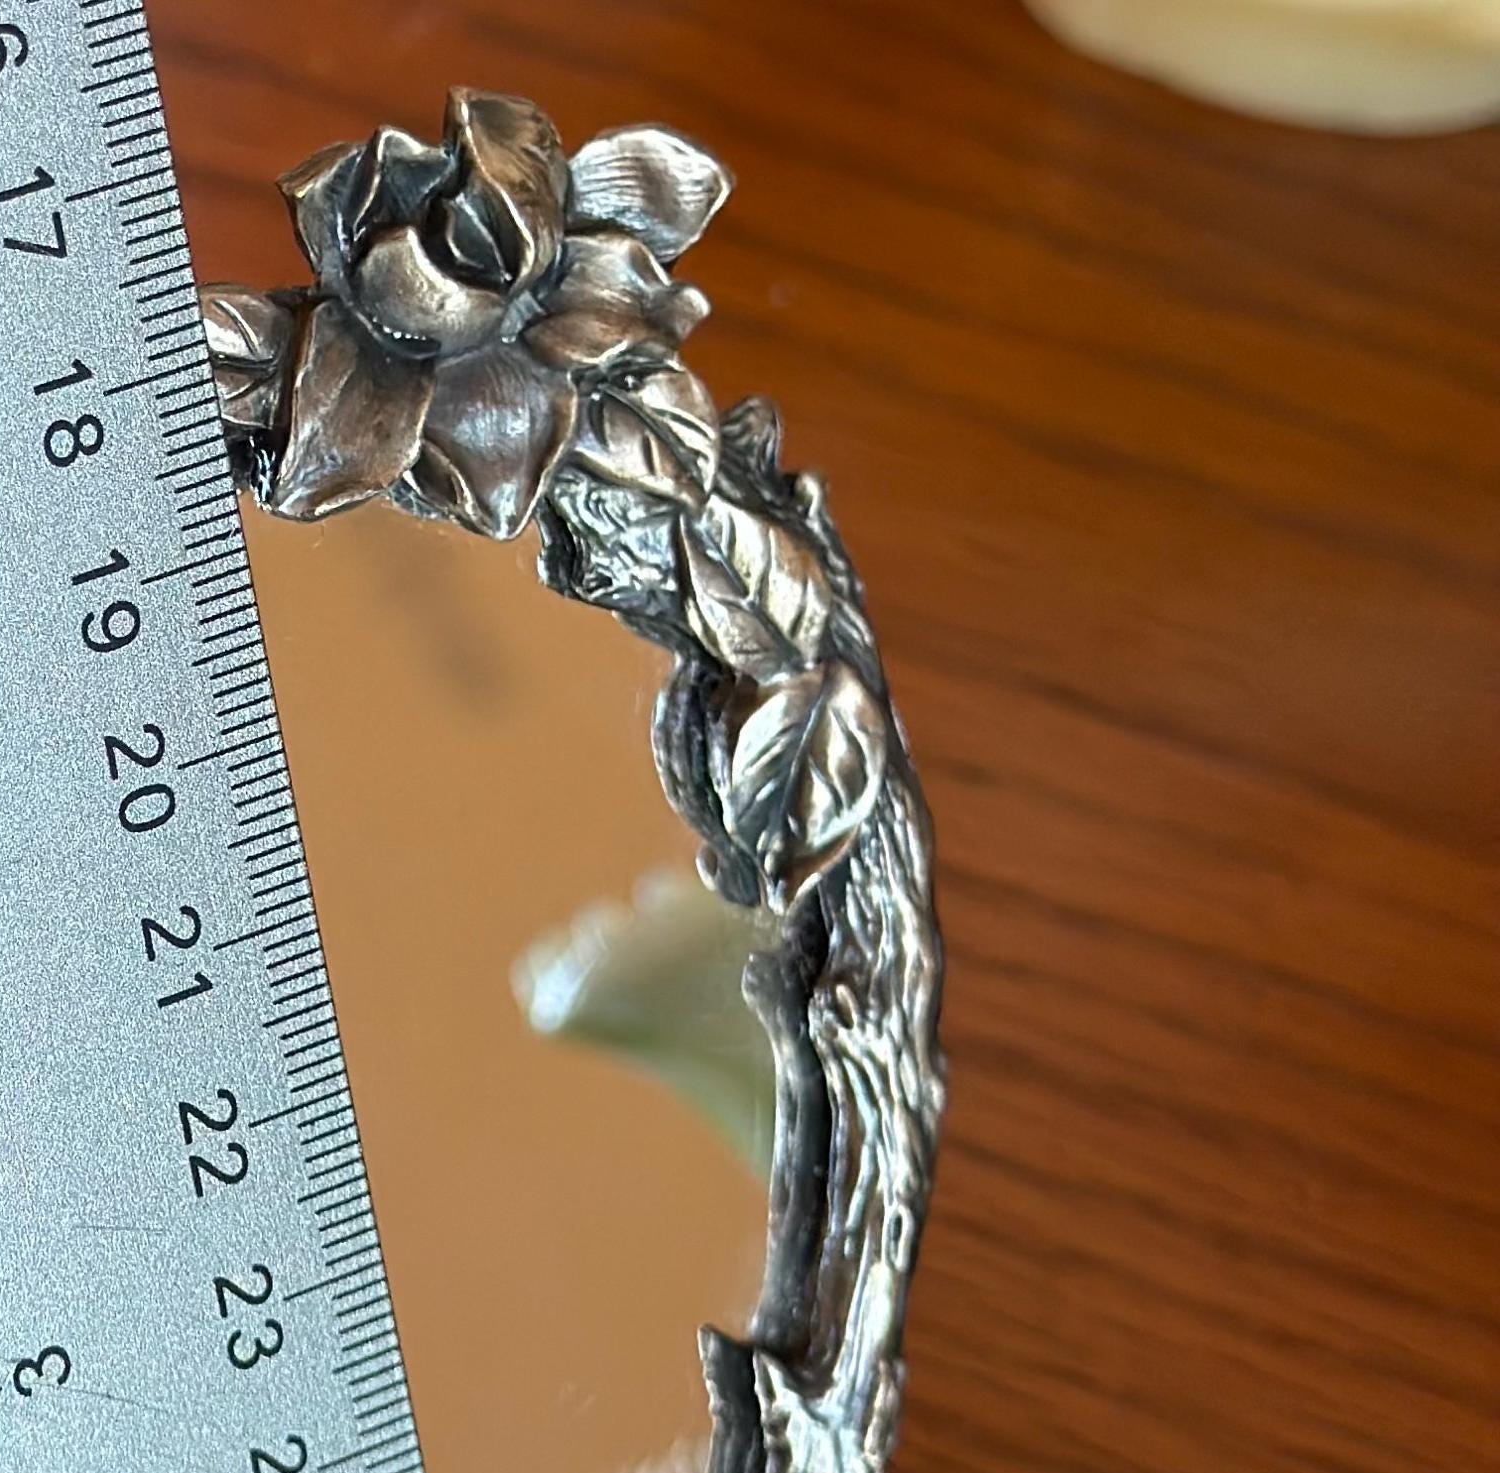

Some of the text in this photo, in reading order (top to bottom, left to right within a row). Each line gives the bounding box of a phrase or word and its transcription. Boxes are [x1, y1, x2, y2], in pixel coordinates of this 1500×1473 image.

[33, 358, 105, 468] 18
[71, 548, 142, 653] 19
[103, 723, 177, 833] 20
[140, 904, 214, 1009] 21
[178, 1088, 249, 1198] 22
[213, 1263, 284, 1371] 23
[12, 1345, 72, 1398] 3
